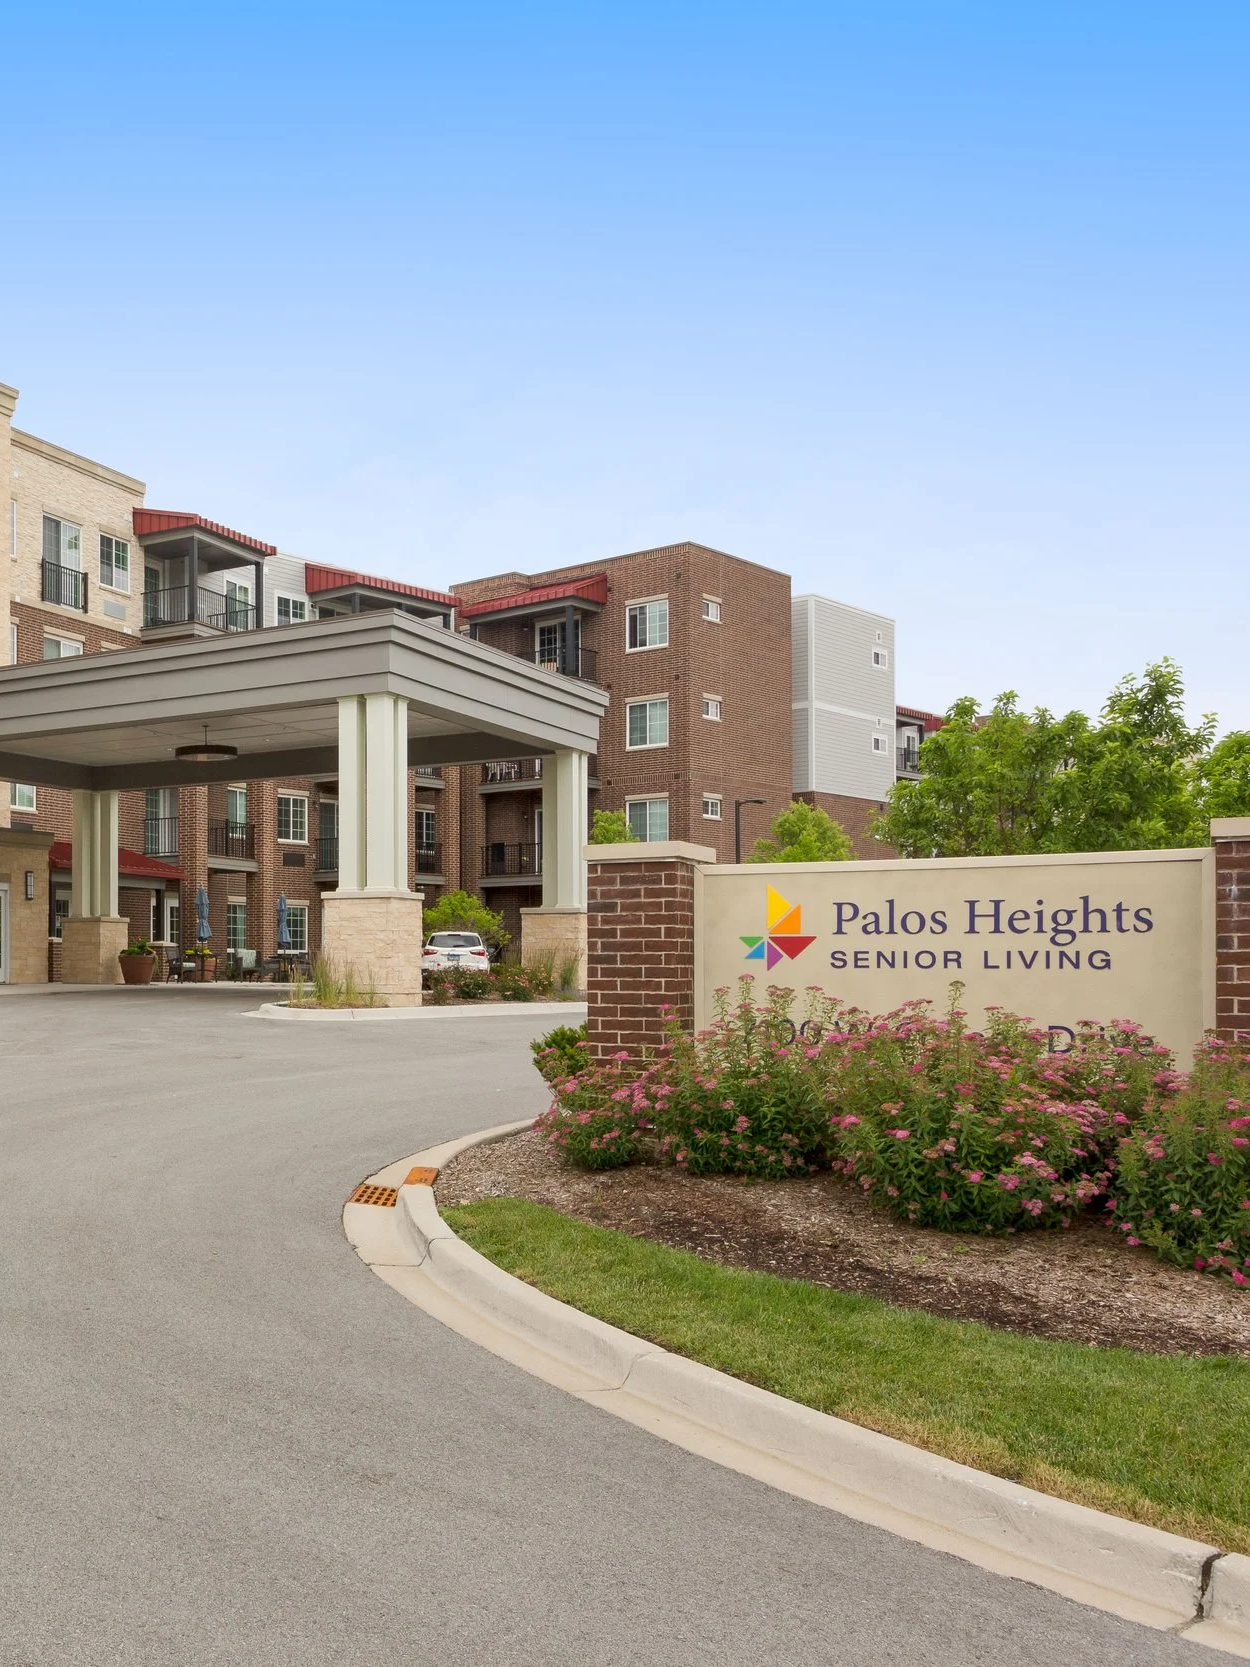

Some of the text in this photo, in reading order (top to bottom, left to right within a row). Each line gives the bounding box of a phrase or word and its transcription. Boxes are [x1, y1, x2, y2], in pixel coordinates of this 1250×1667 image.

[832, 894, 1154, 947] Palos Heights
[830, 948, 1113, 971] SENIOR LIVING
